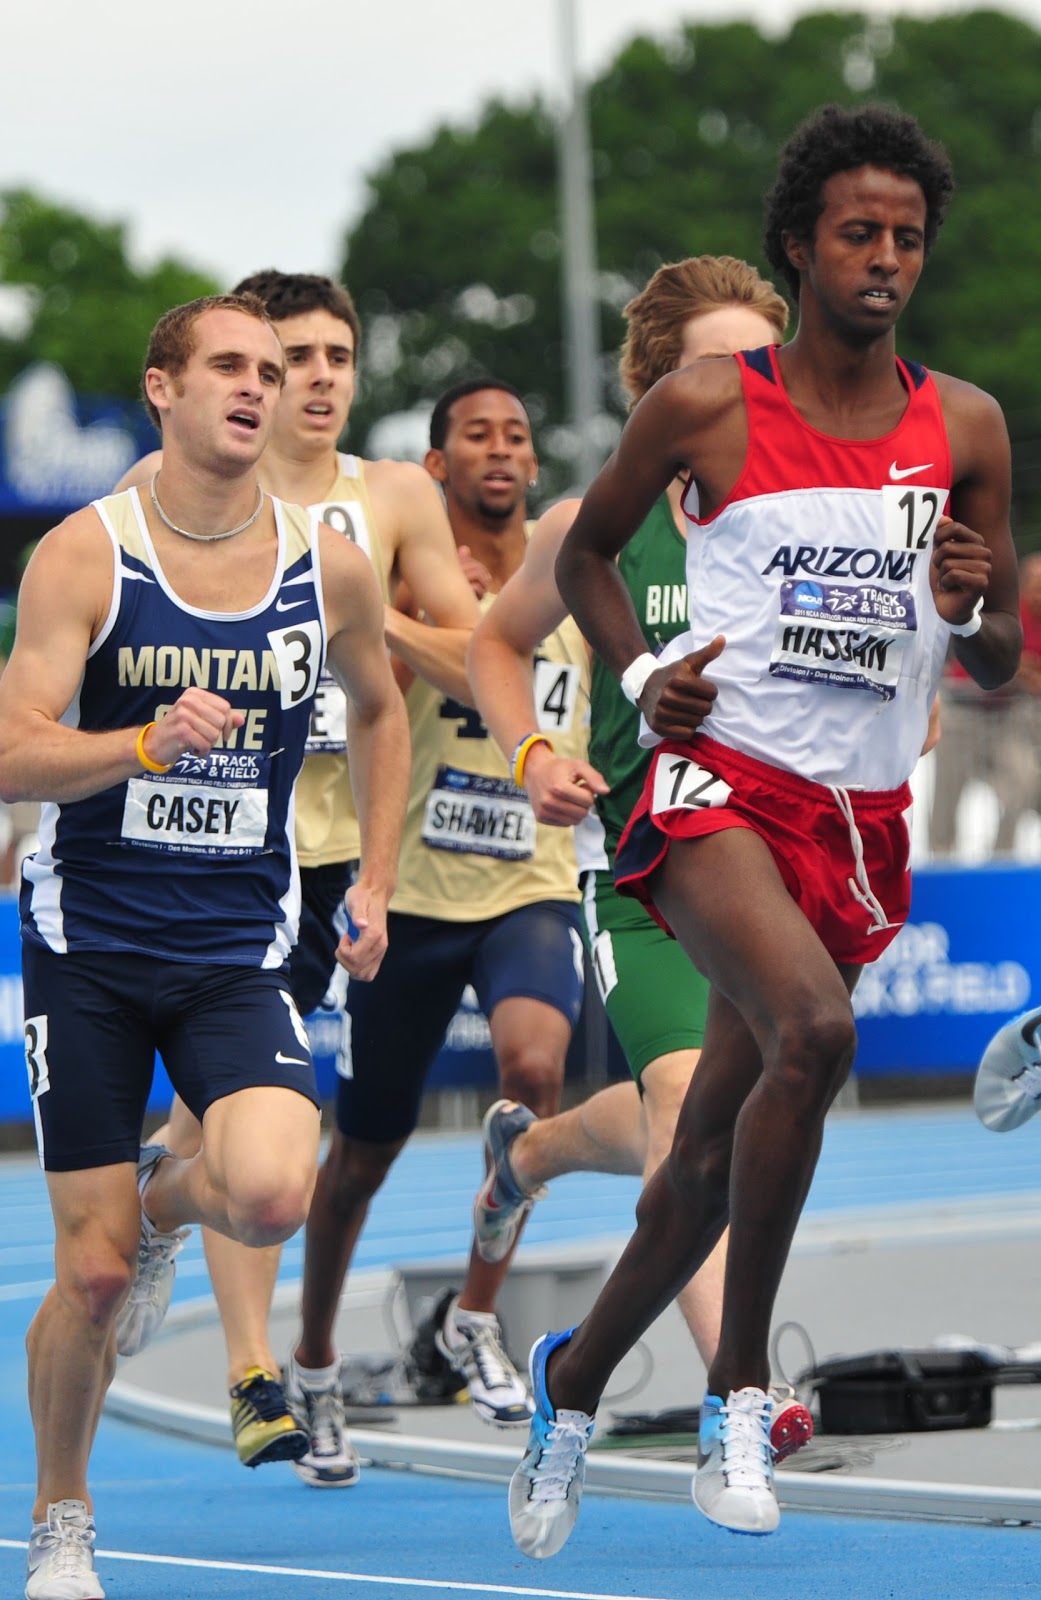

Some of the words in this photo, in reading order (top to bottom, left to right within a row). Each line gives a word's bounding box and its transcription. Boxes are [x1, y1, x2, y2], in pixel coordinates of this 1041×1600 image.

[898, 490, 938, 549] 12
[761, 546, 917, 583] ARIZONA
[646, 584, 690, 625] BIN
[860, 588, 900, 606] TRACK
[860, 601, 870, 613] &
[874, 603, 907, 618] FIELD
[118, 646, 282, 691] MONTAN
[283, 630, 312, 702] 3
[781, 626, 896, 672] HASSAN
[780, 665, 806, 675] Division
[829, 673, 857, 683] Moines,
[543, 671, 568, 726] 4
[166, 776, 188, 784] OUTDOOR
[208, 766, 218, 777] &
[222, 767, 260, 779] FIELD
[210, 754, 257, 767] TRACK
[669, 759, 721, 808] 12
[146, 794, 240, 834] CASEY
[432, 801, 525, 840] SHAWEL
[131, 840, 159, 849] Division
